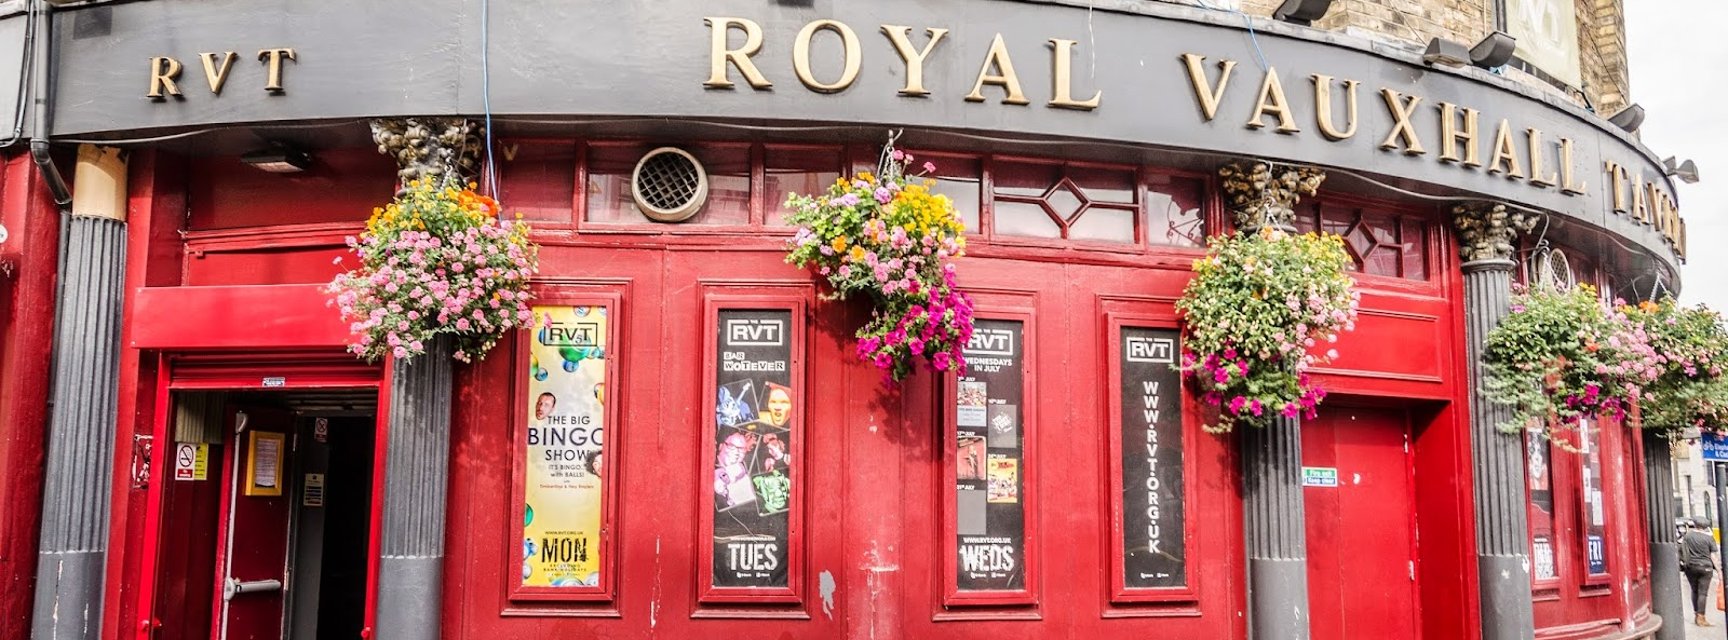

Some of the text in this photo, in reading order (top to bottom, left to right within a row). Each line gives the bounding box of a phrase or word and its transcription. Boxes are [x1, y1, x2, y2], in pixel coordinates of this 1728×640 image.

[147, 47, 298, 98] RVT
[703, 16, 1102, 111] ROYAL
[1180, 52, 1586, 196] VAUXHALL
[550, 328, 593, 341] RVT
[733, 325, 777, 340] RVT
[968, 334, 1008, 349] RVT
[1131, 342, 1168, 357] RVT
[723, 361, 785, 371] WOTEVER
[963, 357, 1013, 366] WEDNESDAYS
[547, 415, 591, 425] THE BIG
[527, 427, 604, 446] BINGO
[545, 449, 588, 461] SHOW
[1143, 381, 1160, 554] WWW.RVT.ORG.UK
[542, 537, 588, 562] MON
[728, 543, 778, 571] TUES
[959, 544, 1014, 571] WEDS
[1588, 541, 1602, 560] FRI
